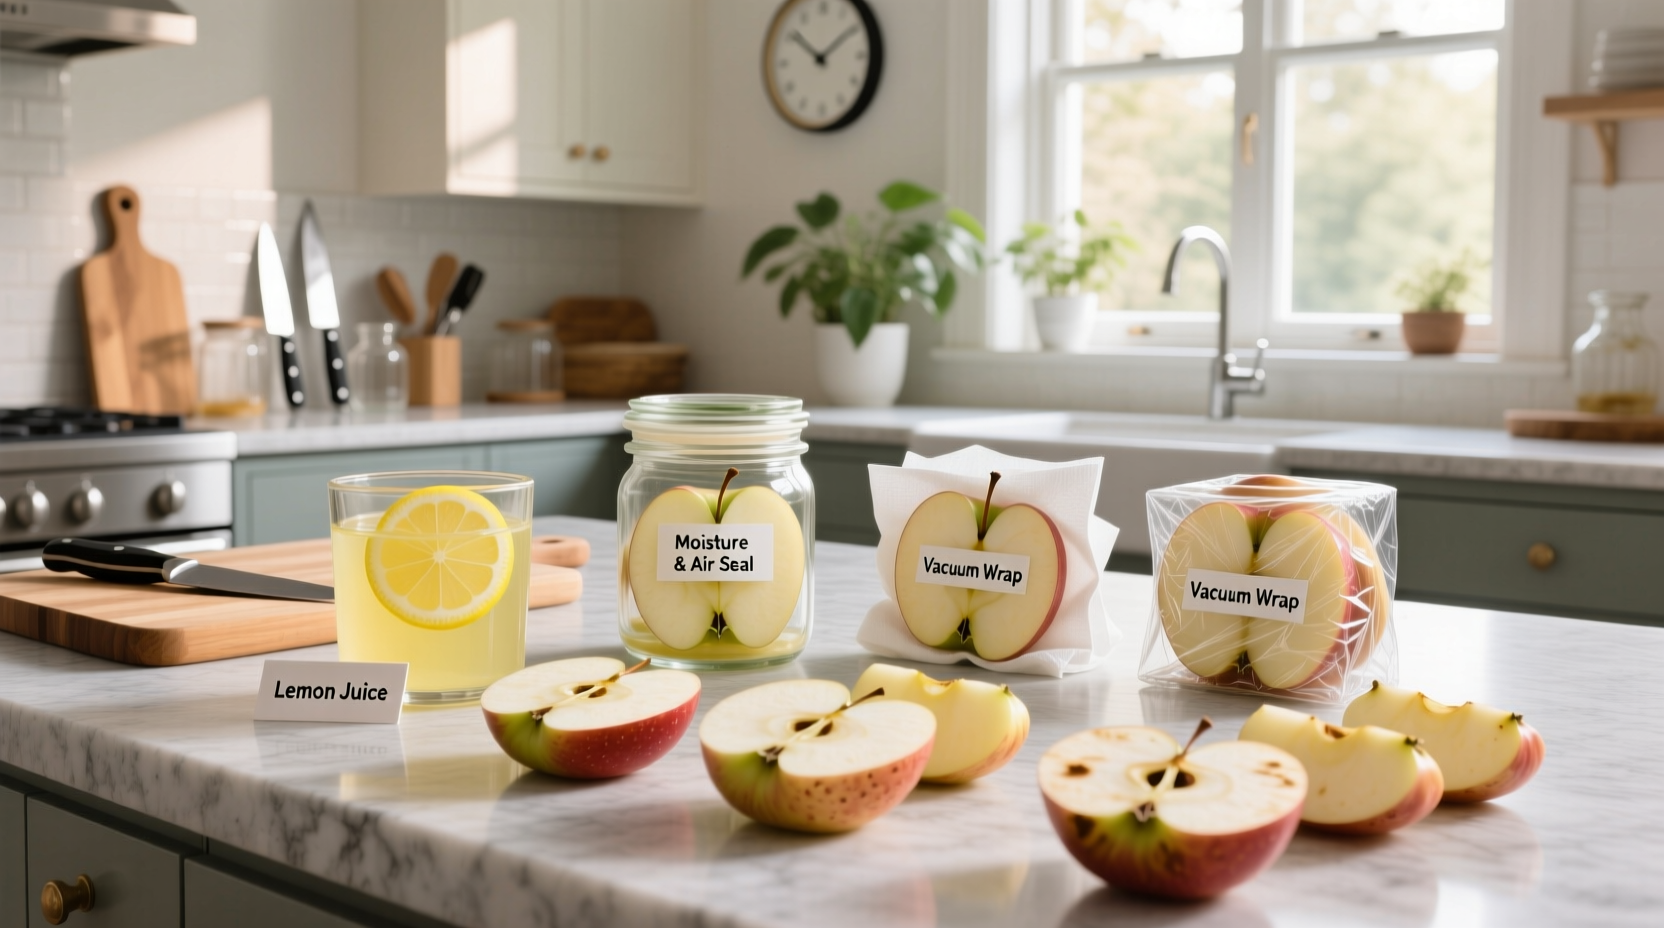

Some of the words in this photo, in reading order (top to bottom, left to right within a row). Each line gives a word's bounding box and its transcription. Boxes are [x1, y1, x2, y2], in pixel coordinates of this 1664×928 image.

[675, 534, 749, 551] Moisture
[673, 555, 687, 572] &
[690, 555, 716, 572] Air
[719, 555, 754, 572] Seal
[923, 556, 980, 579] Vacuum
[983, 562, 1023, 588] Wrap
[1190, 580, 1252, 605] Vacuum
[1256, 587, 1300, 614] Wrap
[274, 680, 336, 700] Lemon
[339, 682, 388, 701] Juice
